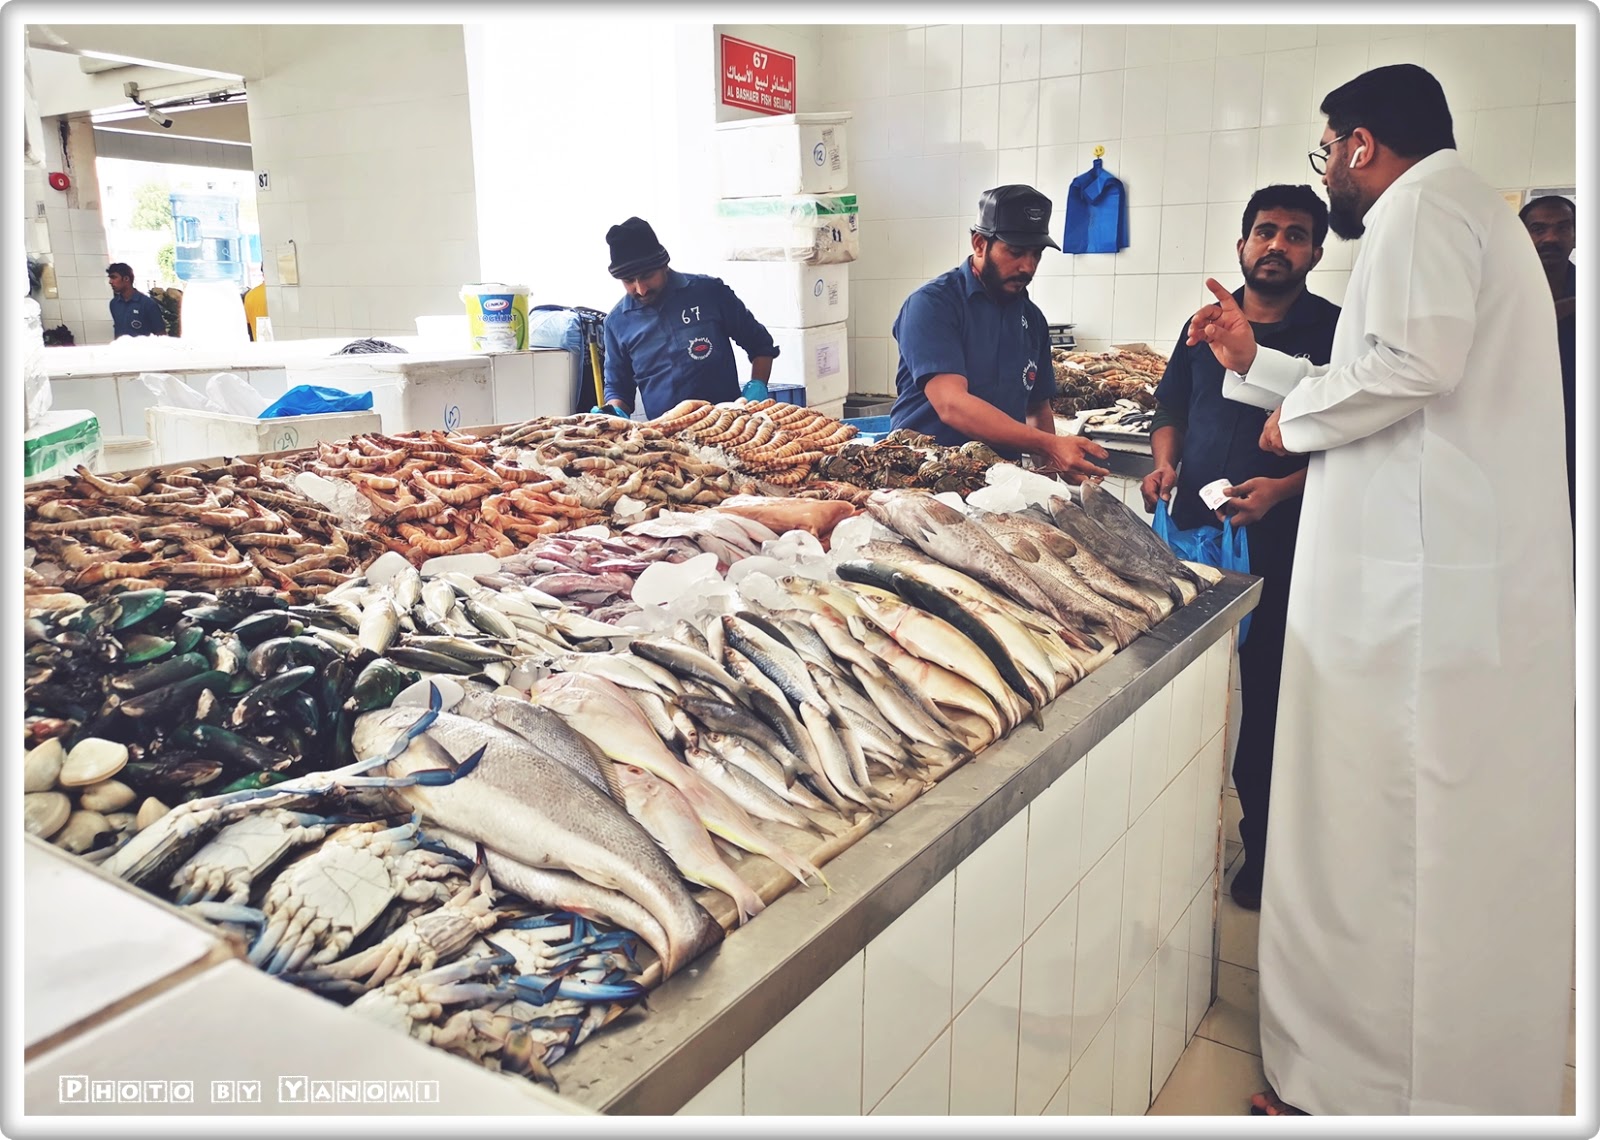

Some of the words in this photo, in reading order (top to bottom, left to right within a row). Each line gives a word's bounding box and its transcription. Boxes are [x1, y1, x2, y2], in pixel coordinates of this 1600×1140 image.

[753, 51, 768, 70] 67
[726, 64, 753, 83] الأسماك
[755, 74, 768, 91] لبيع
[727, 85, 734, 97] AL
[736, 87, 759, 103] BASHAER
[761, 93, 772, 106] FISH
[773, 97, 791, 111] SELLING
[258, 173, 268, 188] 87
[681, 305, 701, 324] 67
[277, 432, 295, 451] 29
